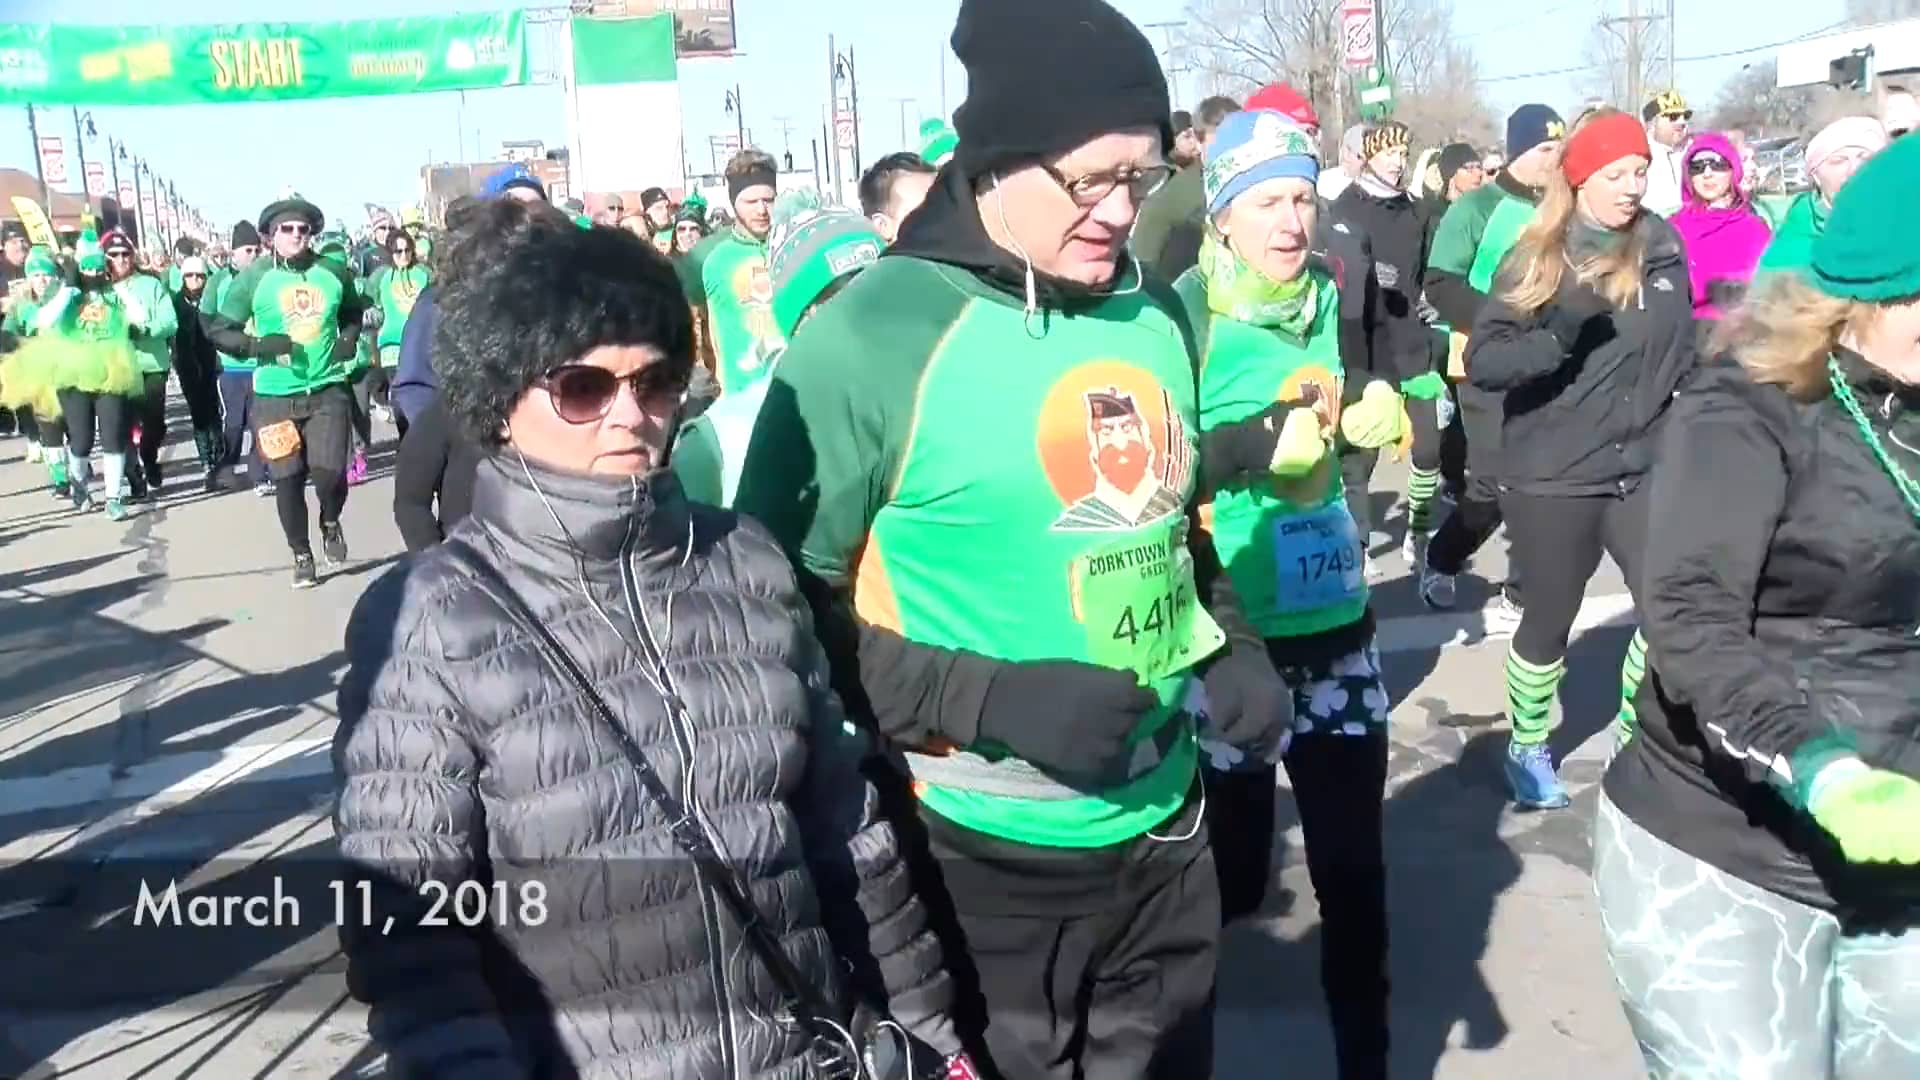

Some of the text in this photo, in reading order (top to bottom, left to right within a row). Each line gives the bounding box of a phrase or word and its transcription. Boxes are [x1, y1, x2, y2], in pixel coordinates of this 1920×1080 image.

[209, 39, 303, 88] START
[1089, 540, 1166, 577] CORKTOWN
[1297, 545, 1354, 584] 1749
